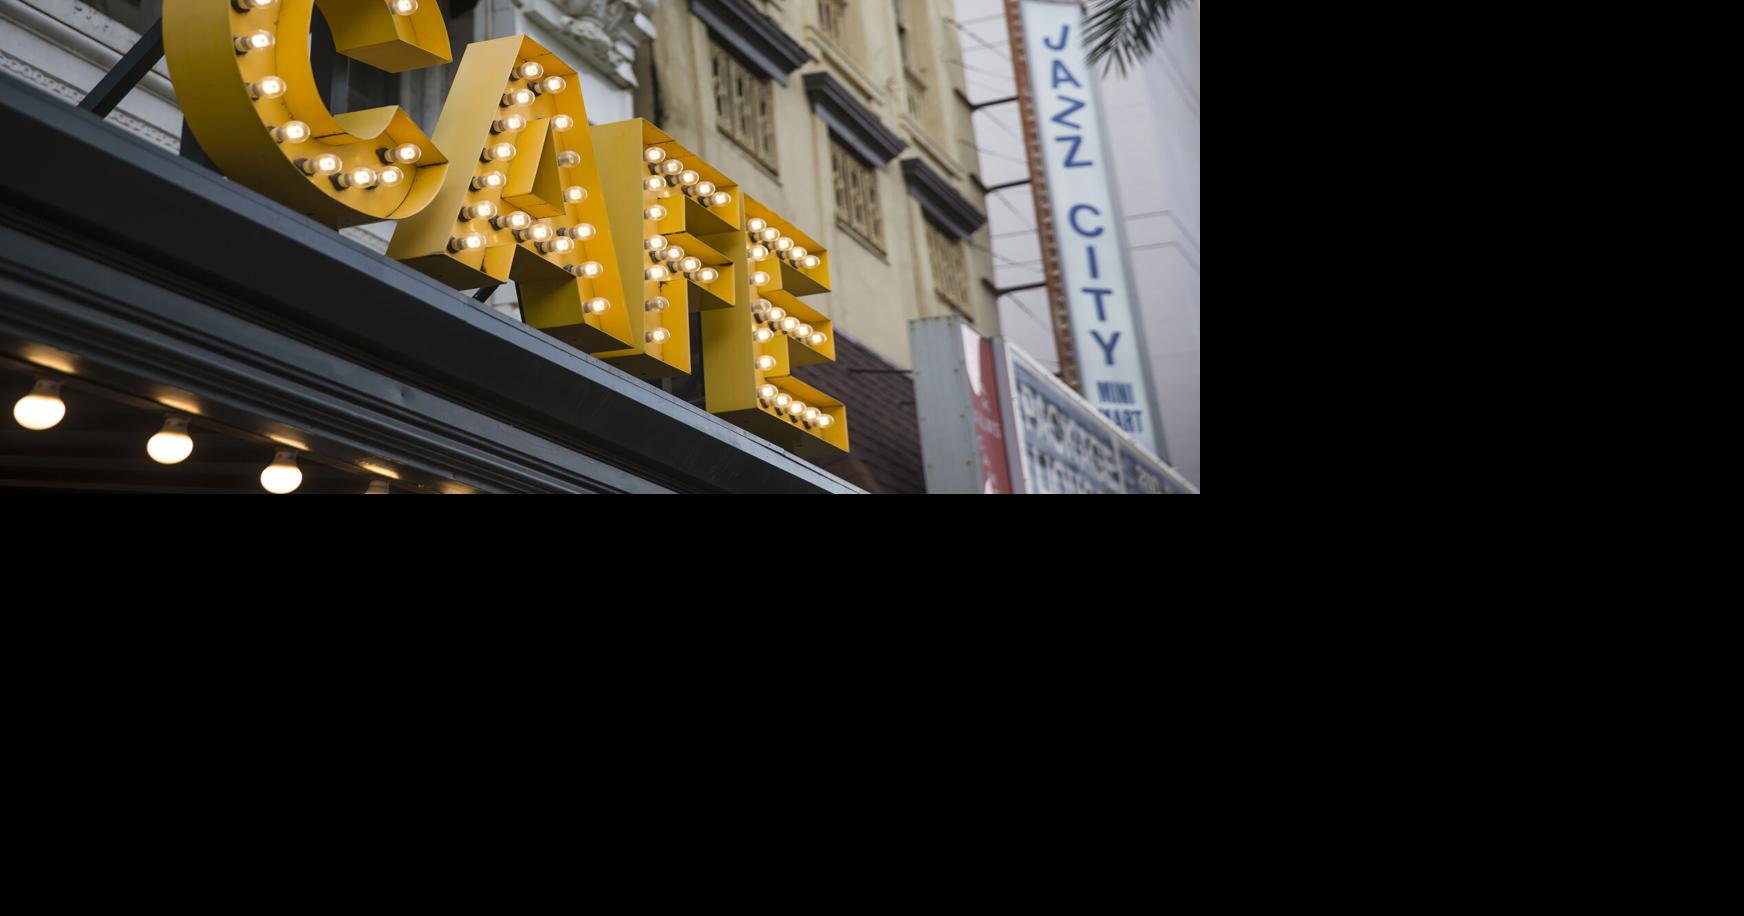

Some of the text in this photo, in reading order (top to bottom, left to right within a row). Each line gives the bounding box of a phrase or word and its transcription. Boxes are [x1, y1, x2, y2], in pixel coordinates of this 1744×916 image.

[163, 0, 849, 453] CAFE
[1043, 24, 1121, 366] JAZZ CITY
[1097, 381, 1135, 405] MINI
